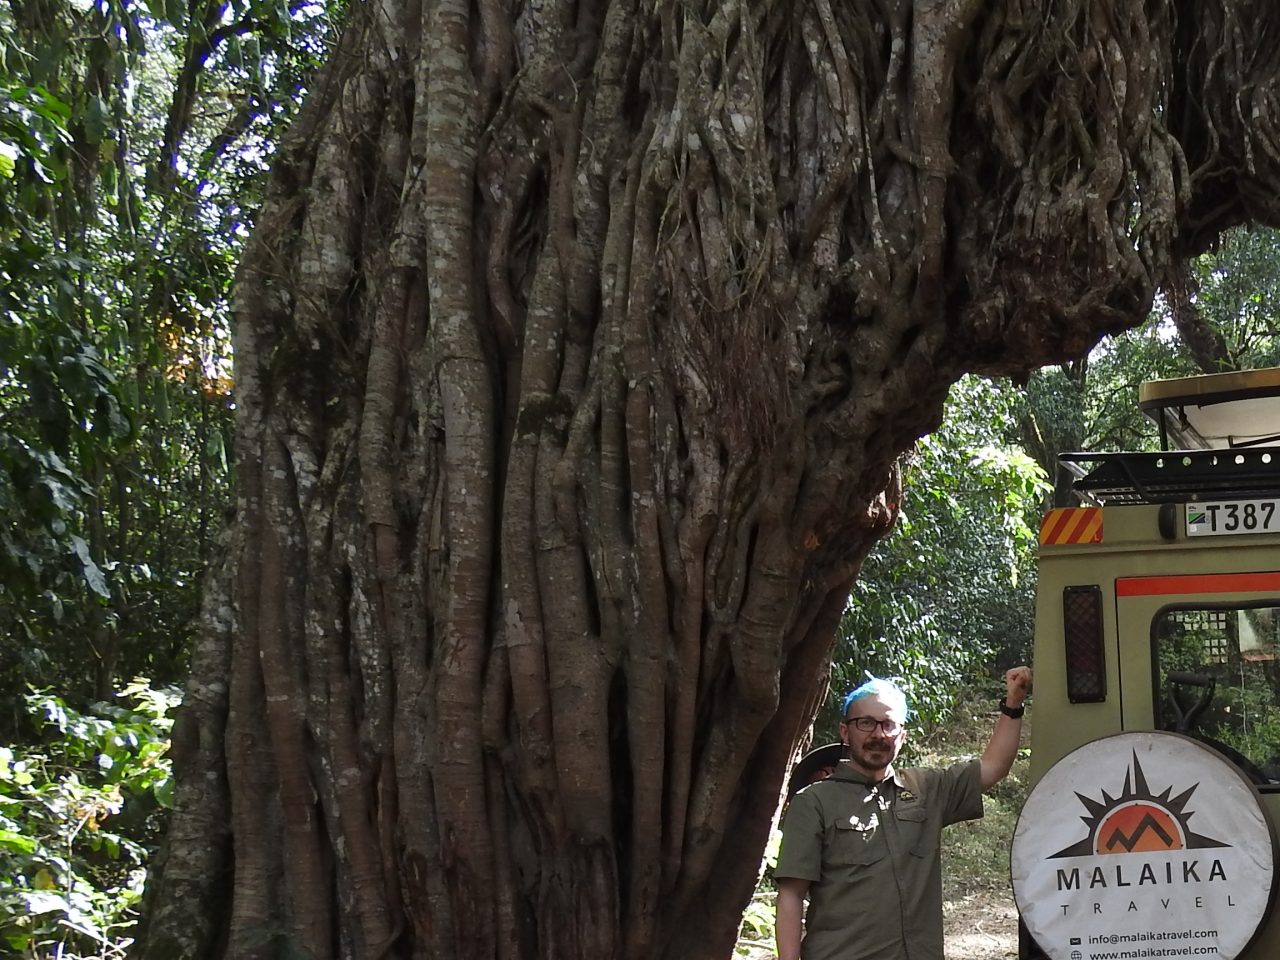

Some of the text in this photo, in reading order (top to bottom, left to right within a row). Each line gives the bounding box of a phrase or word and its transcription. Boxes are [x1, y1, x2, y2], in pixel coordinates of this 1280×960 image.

[1206, 502, 1276, 532] T387
[1056, 859, 1227, 891] MALAIKA
[1060, 895, 1236, 916] TRAVEL
[1088, 929, 1218, 945] info@malaikatravel.com
[1089, 945, 1218, 960] www.malaikatravel.com
